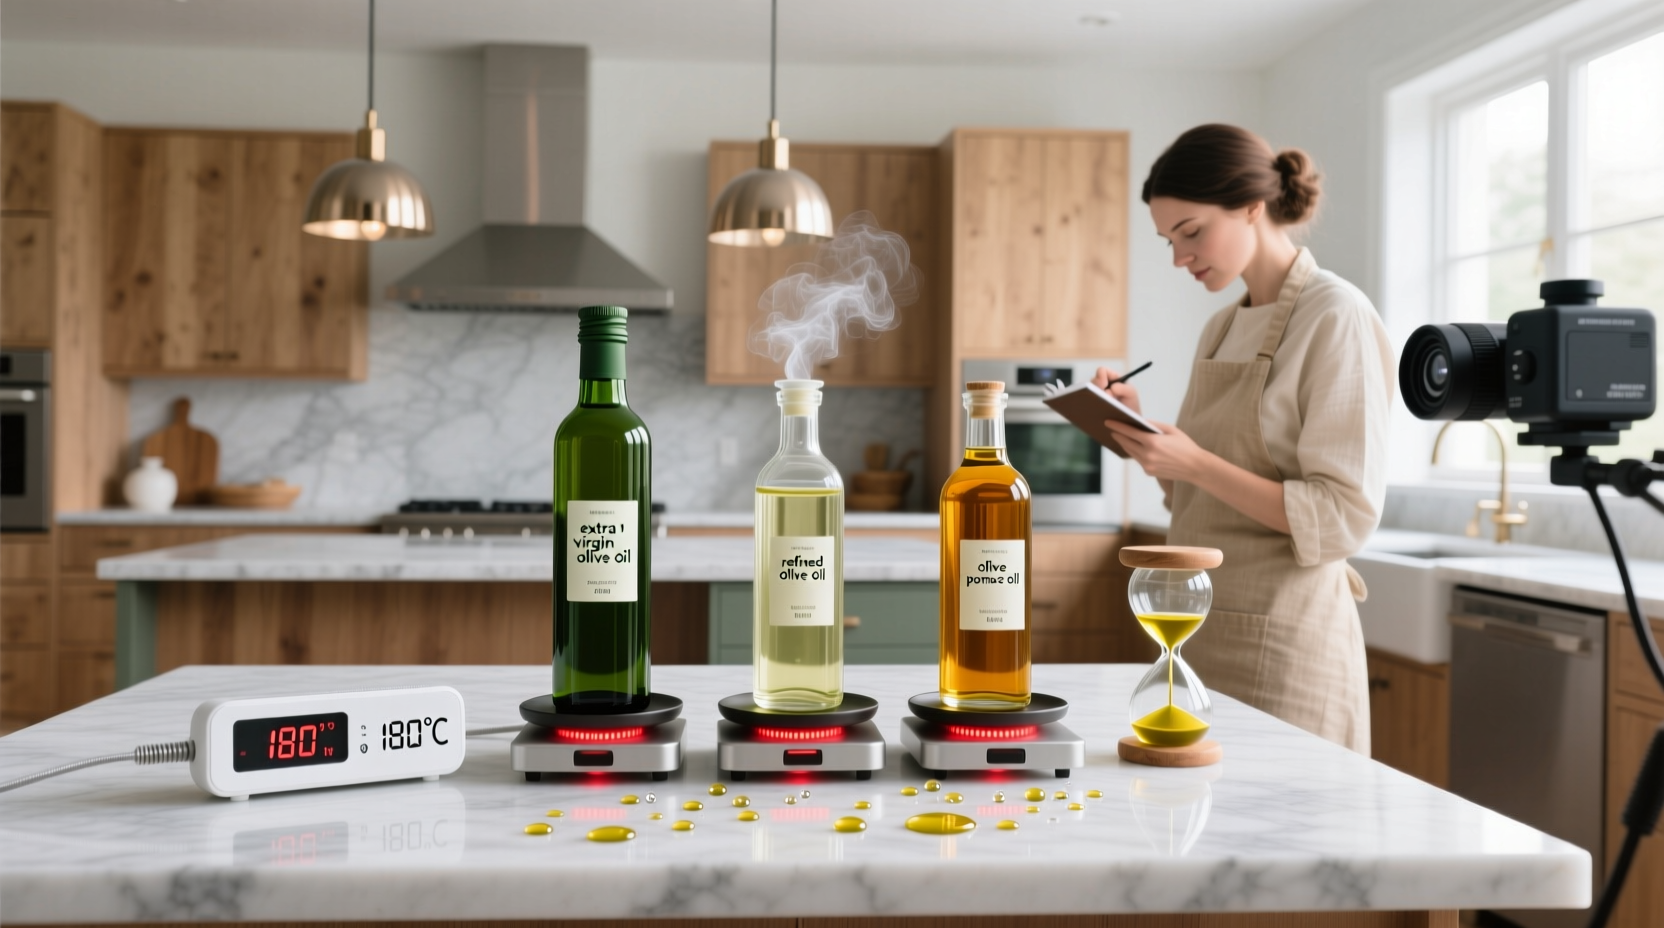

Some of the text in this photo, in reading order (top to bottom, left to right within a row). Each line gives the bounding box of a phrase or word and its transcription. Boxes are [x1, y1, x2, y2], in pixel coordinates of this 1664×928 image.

[580, 522, 616, 534] extra
[573, 535, 615, 552] virgin
[577, 549, 631, 563] olive oil
[268, 724, 318, 759] 180
[382, 716, 449, 751] 180°C
